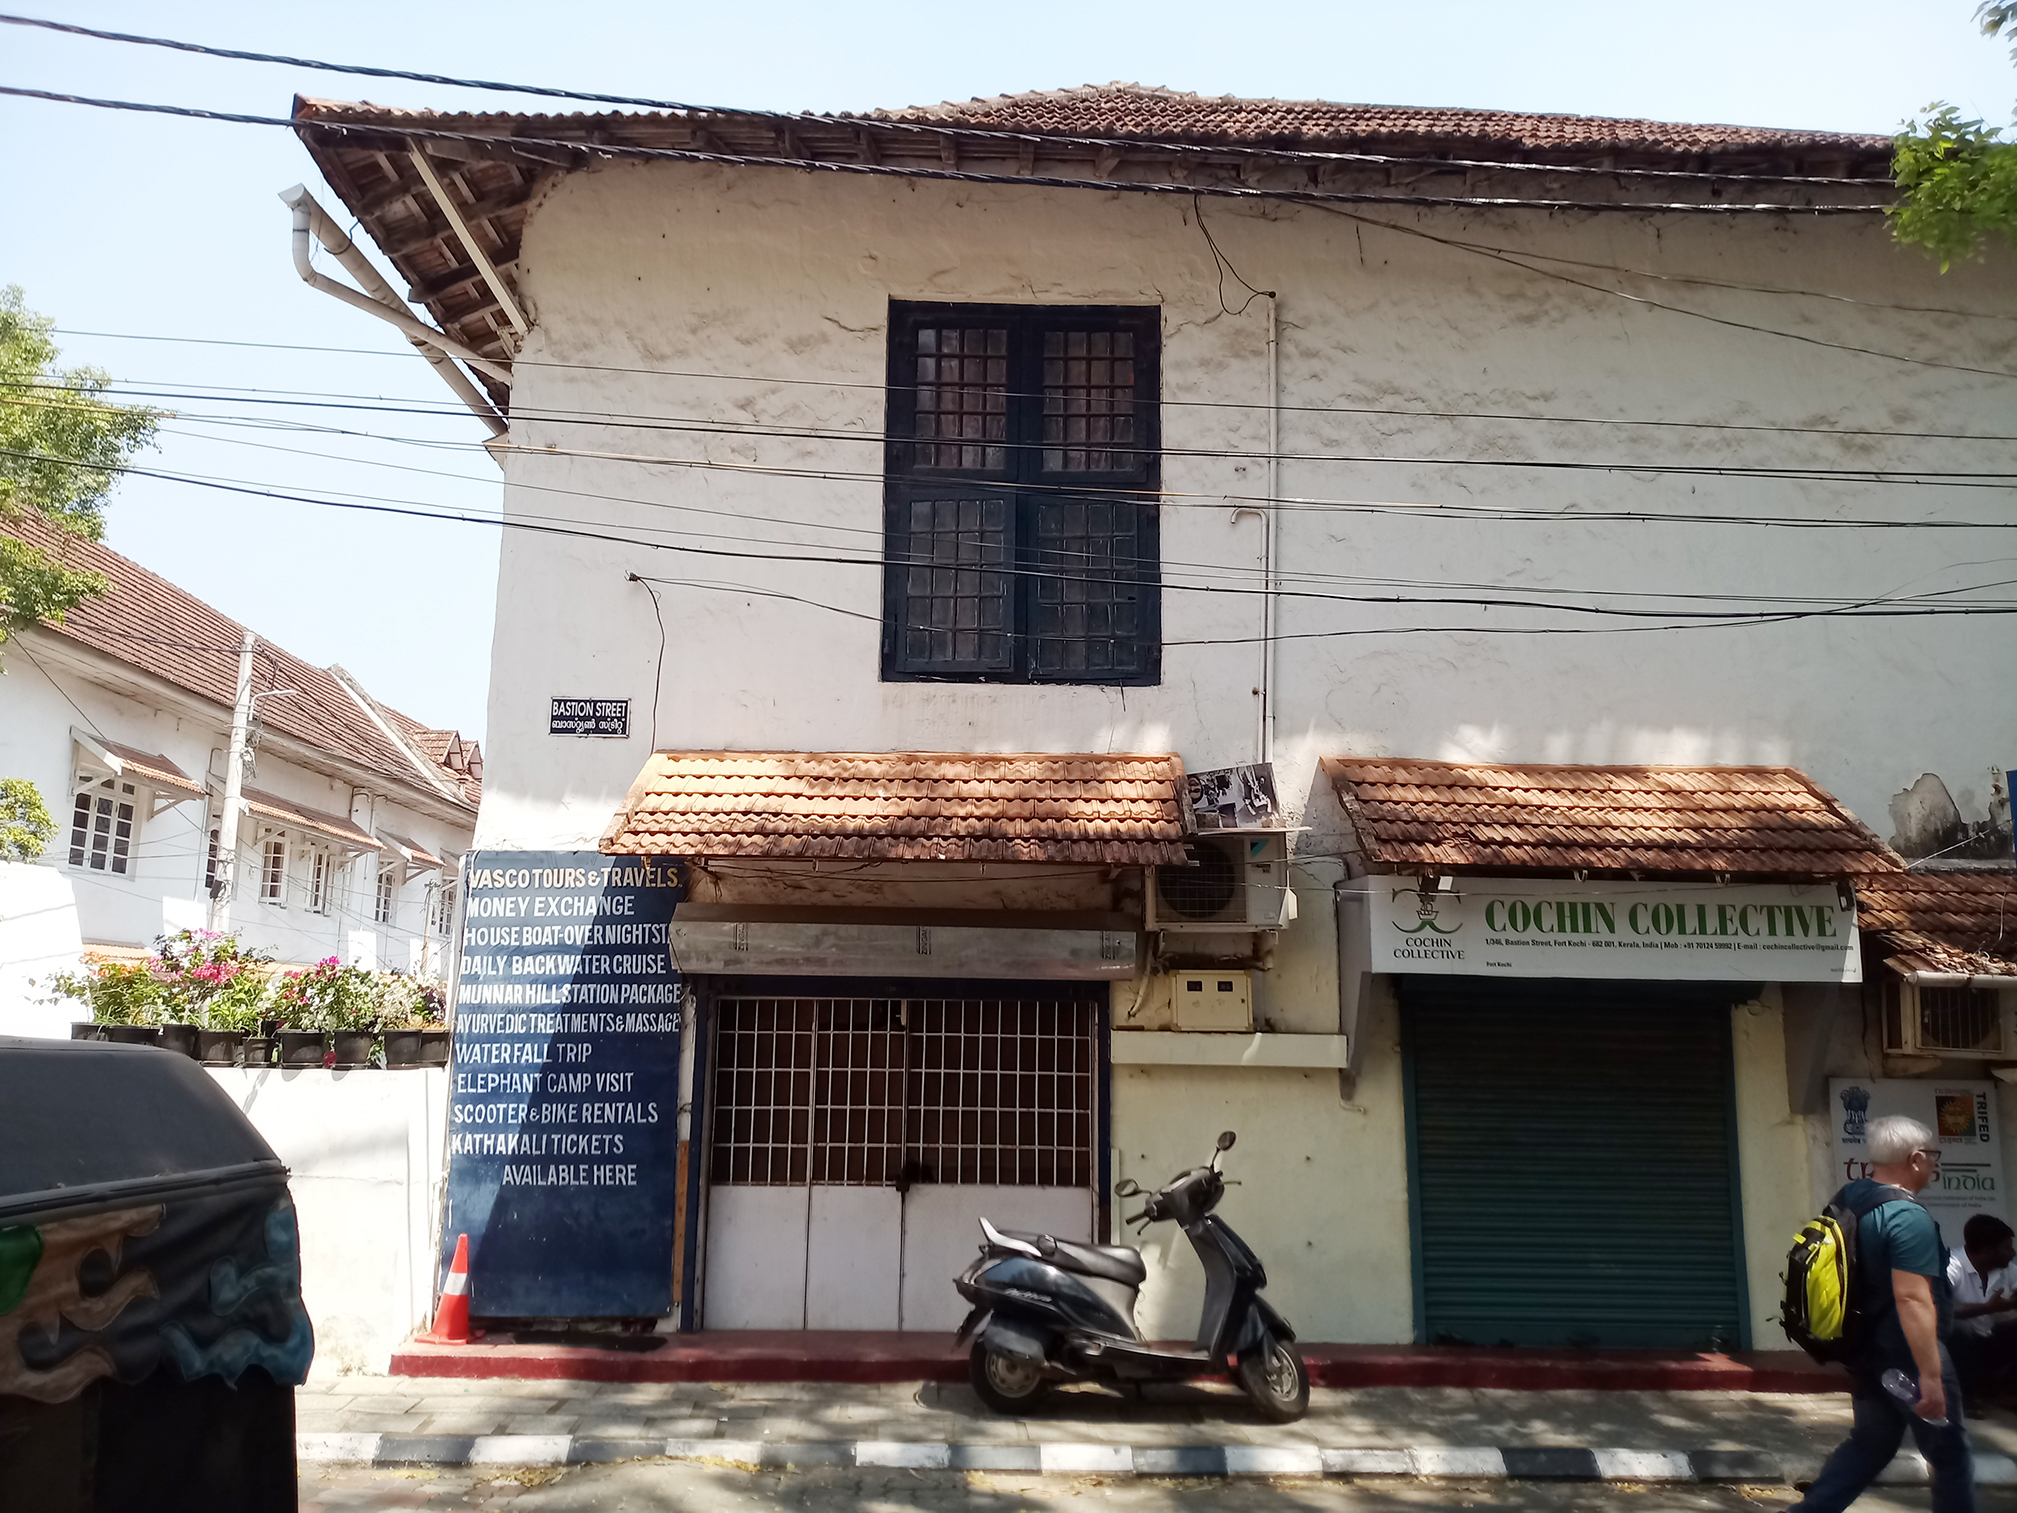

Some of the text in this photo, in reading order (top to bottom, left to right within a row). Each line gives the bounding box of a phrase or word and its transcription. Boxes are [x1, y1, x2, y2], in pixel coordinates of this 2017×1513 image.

[552, 701, 627, 717] BASTION STREET
[469, 868, 530, 889] VASCO
[532, 868, 588, 888] TOURS
[600, 866, 679, 888] TRAVELS
[466, 895, 635, 917] MONEY EXCHANGE
[1484, 899, 1837, 937] COCHIN COLLECTIVE
[464, 925, 520, 946] HOUSE
[1405, 937, 1452, 948] COCHIN
[1505, 938, 1530, 946] Bastion
[1553, 939, 1567, 947] Fort
[1568, 939, 1587, 947] Kochi
[1642, 941, 1659, 949] India
[461, 954, 667, 975] DAILY BACKWATER CRUISE
[1393, 948, 1465, 960] COLLECTIVE
[458, 983, 523, 1005] MUNNAR
[456, 1013, 527, 1034] AYURVEDIC
[556, 1043, 592, 1063] TRIP
[457, 1071, 634, 1094] ELEPHANT CAMP VISIT
[454, 1103, 529, 1124] SCOOTER
[541, 1103, 578, 1124] BIKE
[582, 1102, 659, 1124] RENTALS
[1976, 1092, 1990, 1143] TRIFED
[450, 1132, 625, 1156] KATHAKALI TICKETS
[501, 1163, 637, 1187] AVAILABLE HERE
